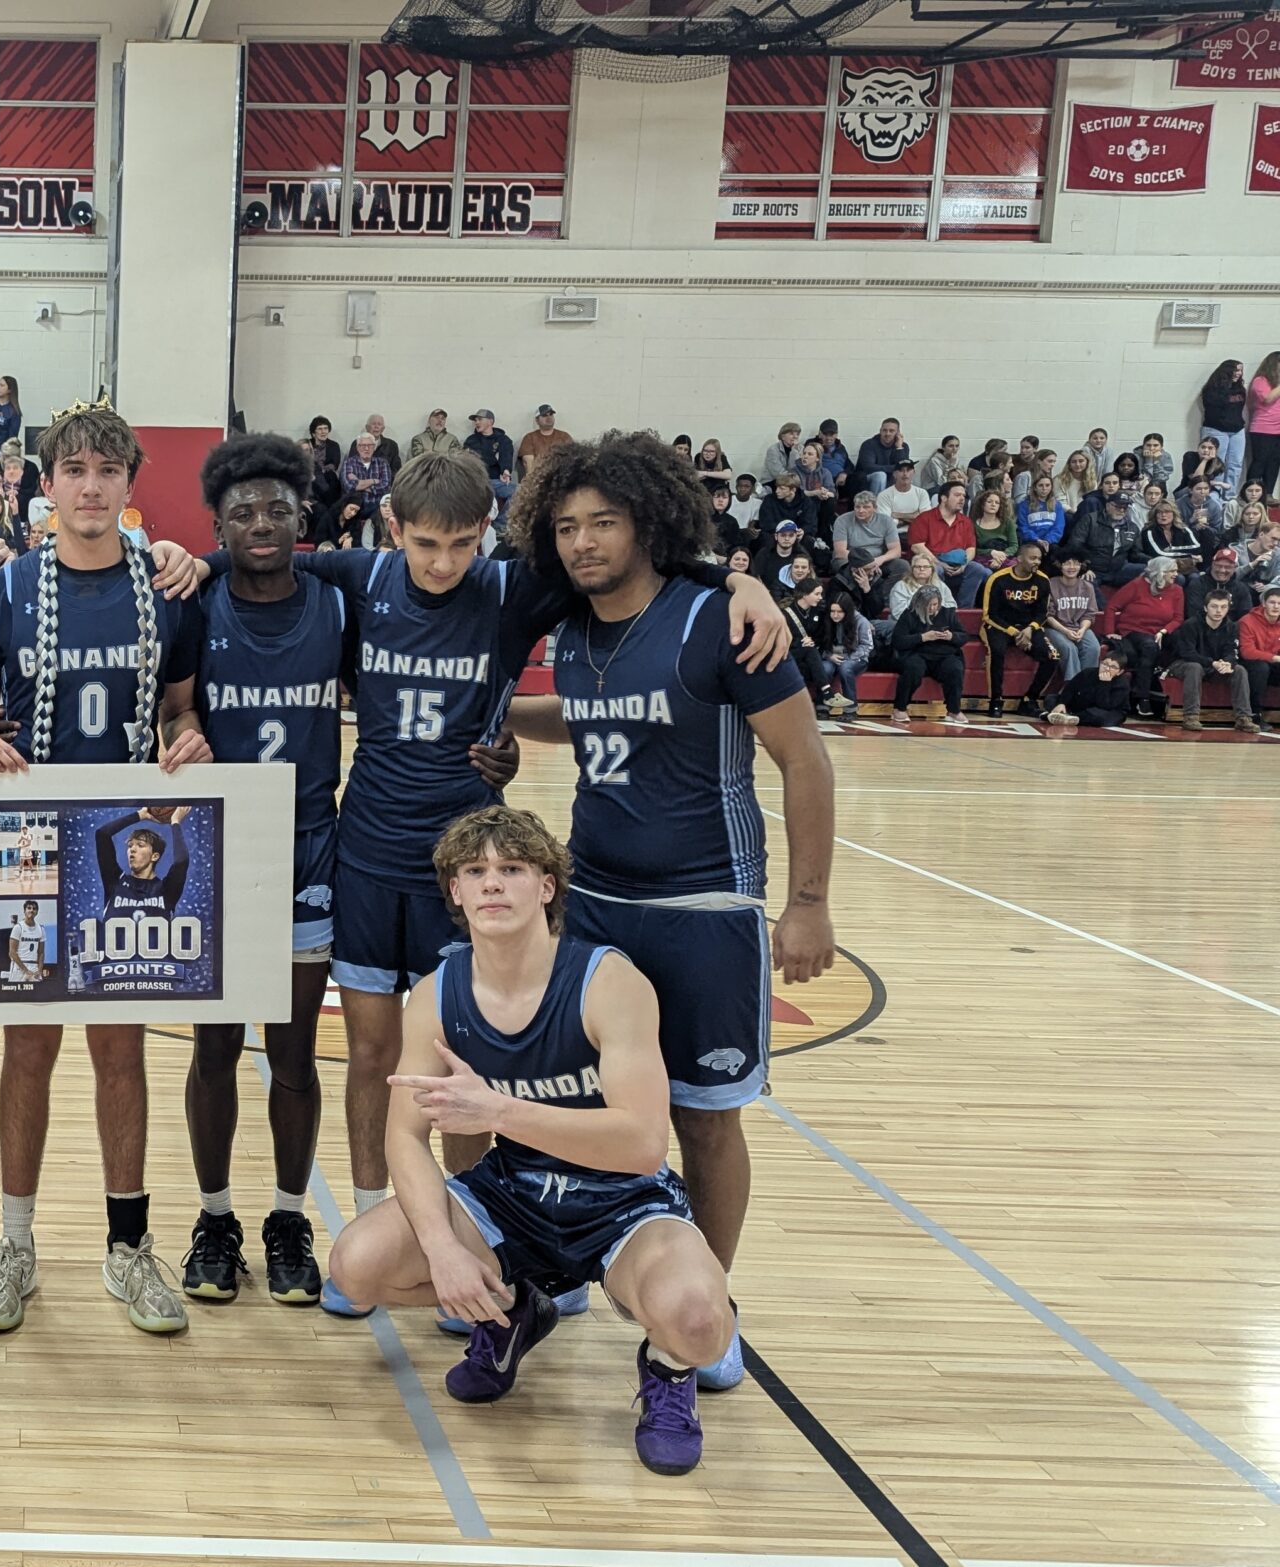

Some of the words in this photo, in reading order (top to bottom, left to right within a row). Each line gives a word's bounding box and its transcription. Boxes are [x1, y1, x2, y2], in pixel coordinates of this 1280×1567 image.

[1202, 39, 1234, 50] CLASS
[1209, 49, 1223, 60] CC
[1200, 63, 1237, 80] BOYS
[1247, 67, 1280, 81] TENN
[1080, 116, 1132, 134] SECTION
[1136, 115, 1150, 128] V
[1153, 116, 1205, 135] CHAMPS
[1108, 144, 1124, 155] 20
[1152, 144, 1166, 155] 21
[1089, 166, 1124, 184] BOYS
[1134, 167, 1186, 185] SOCCER
[1256, 159, 1280, 180] GIRL
[266, 181, 534, 234] MARAUDERS
[732, 203, 760, 216] DEEP
[762, 203, 799, 217] ROOTS
[828, 203, 870, 217] BRIGHT
[873, 203, 926, 217] FUTURES
[983, 205, 1028, 219] VALUES
[18, 641, 162, 678] GNAND
[362, 640, 490, 685] GANANDA
[206, 677, 338, 712] GANANDA
[79, 681, 108, 737] 0
[397, 687, 446, 742] 15
[561, 689, 675, 725] ANANDA
[258, 720, 286, 763] 2
[583, 731, 630, 785] 22
[114, 895, 165, 909] GANANDA
[80, 916, 201, 963] 1,000
[72, 960, 78, 968] 2
[101, 963, 176, 977] POINTS
[104, 981, 135, 991] COOPER
[137, 981, 173, 991] GRASSEL
[489, 1064, 602, 1099] NANDA
